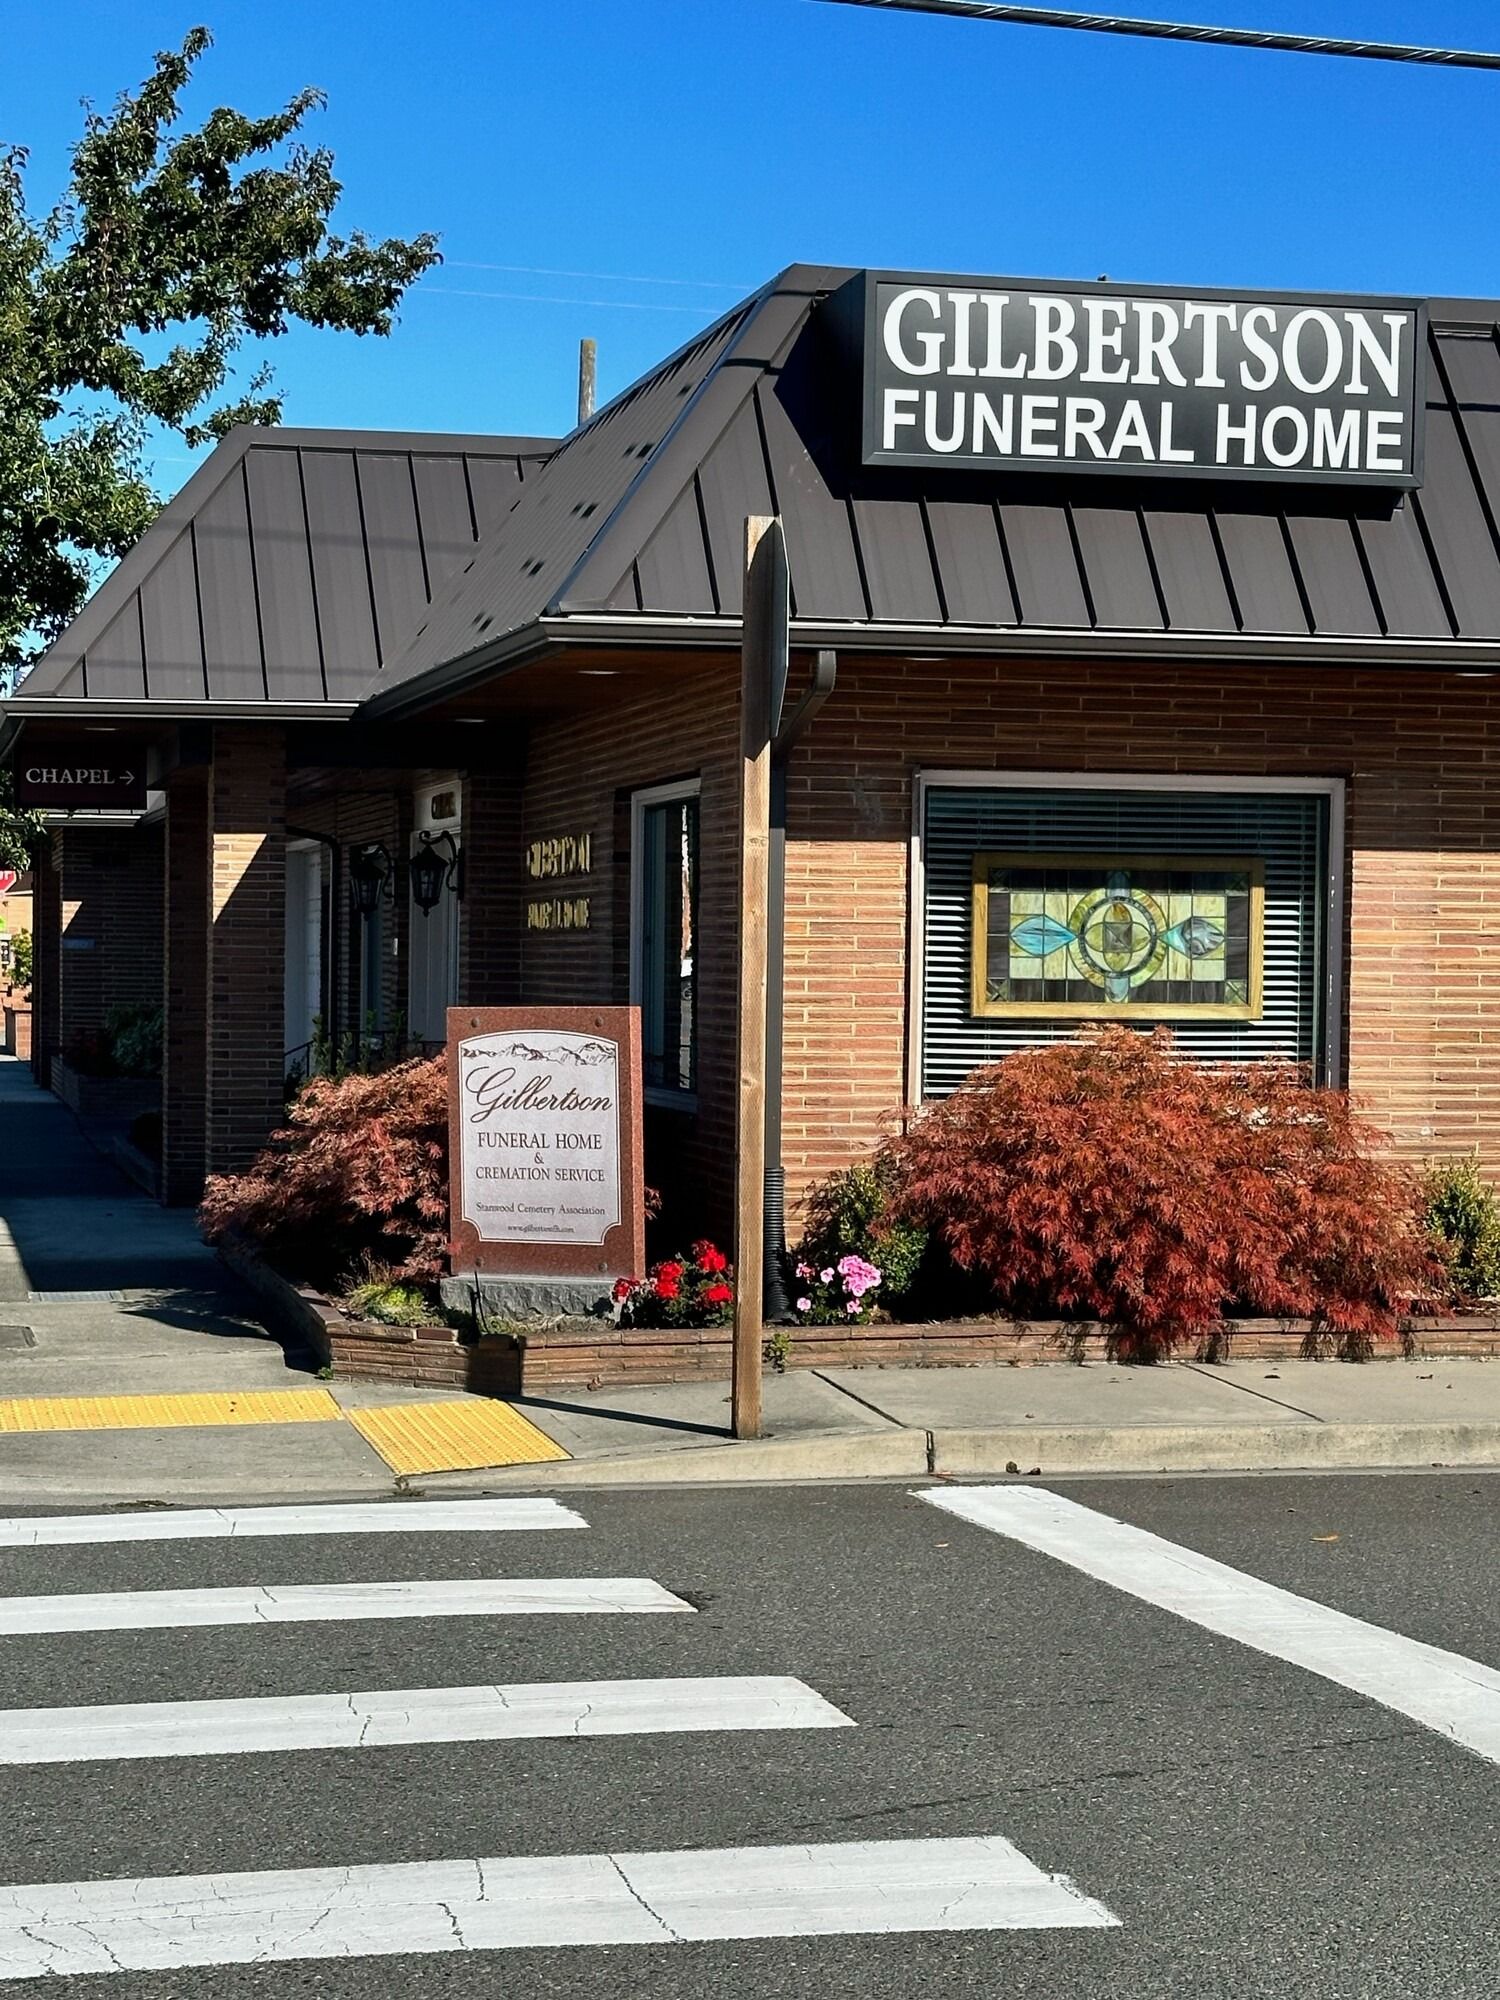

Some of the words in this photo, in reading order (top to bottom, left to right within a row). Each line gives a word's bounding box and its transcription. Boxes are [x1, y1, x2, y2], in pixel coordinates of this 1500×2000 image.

[882, 289, 1408, 397] GILBERTSON
[882, 388, 1195, 463] FUNERAL
[1215, 402, 1404, 471] HOME
[25, 768, 115, 784] CHAPEL
[465, 1066, 613, 1123] Gilbertson
[478, 1132, 550, 1149] FUNERAL
[555, 1133, 602, 1150] HOME
[534, 1152, 544, 1165] &
[475, 1166, 550, 1181] CREMATION
[555, 1168, 605, 1182] SERVICE
[476, 1202, 515, 1214] Stanwood
[517, 1203, 556, 1216] Cemetery
[558, 1204, 605, 1215] Association
